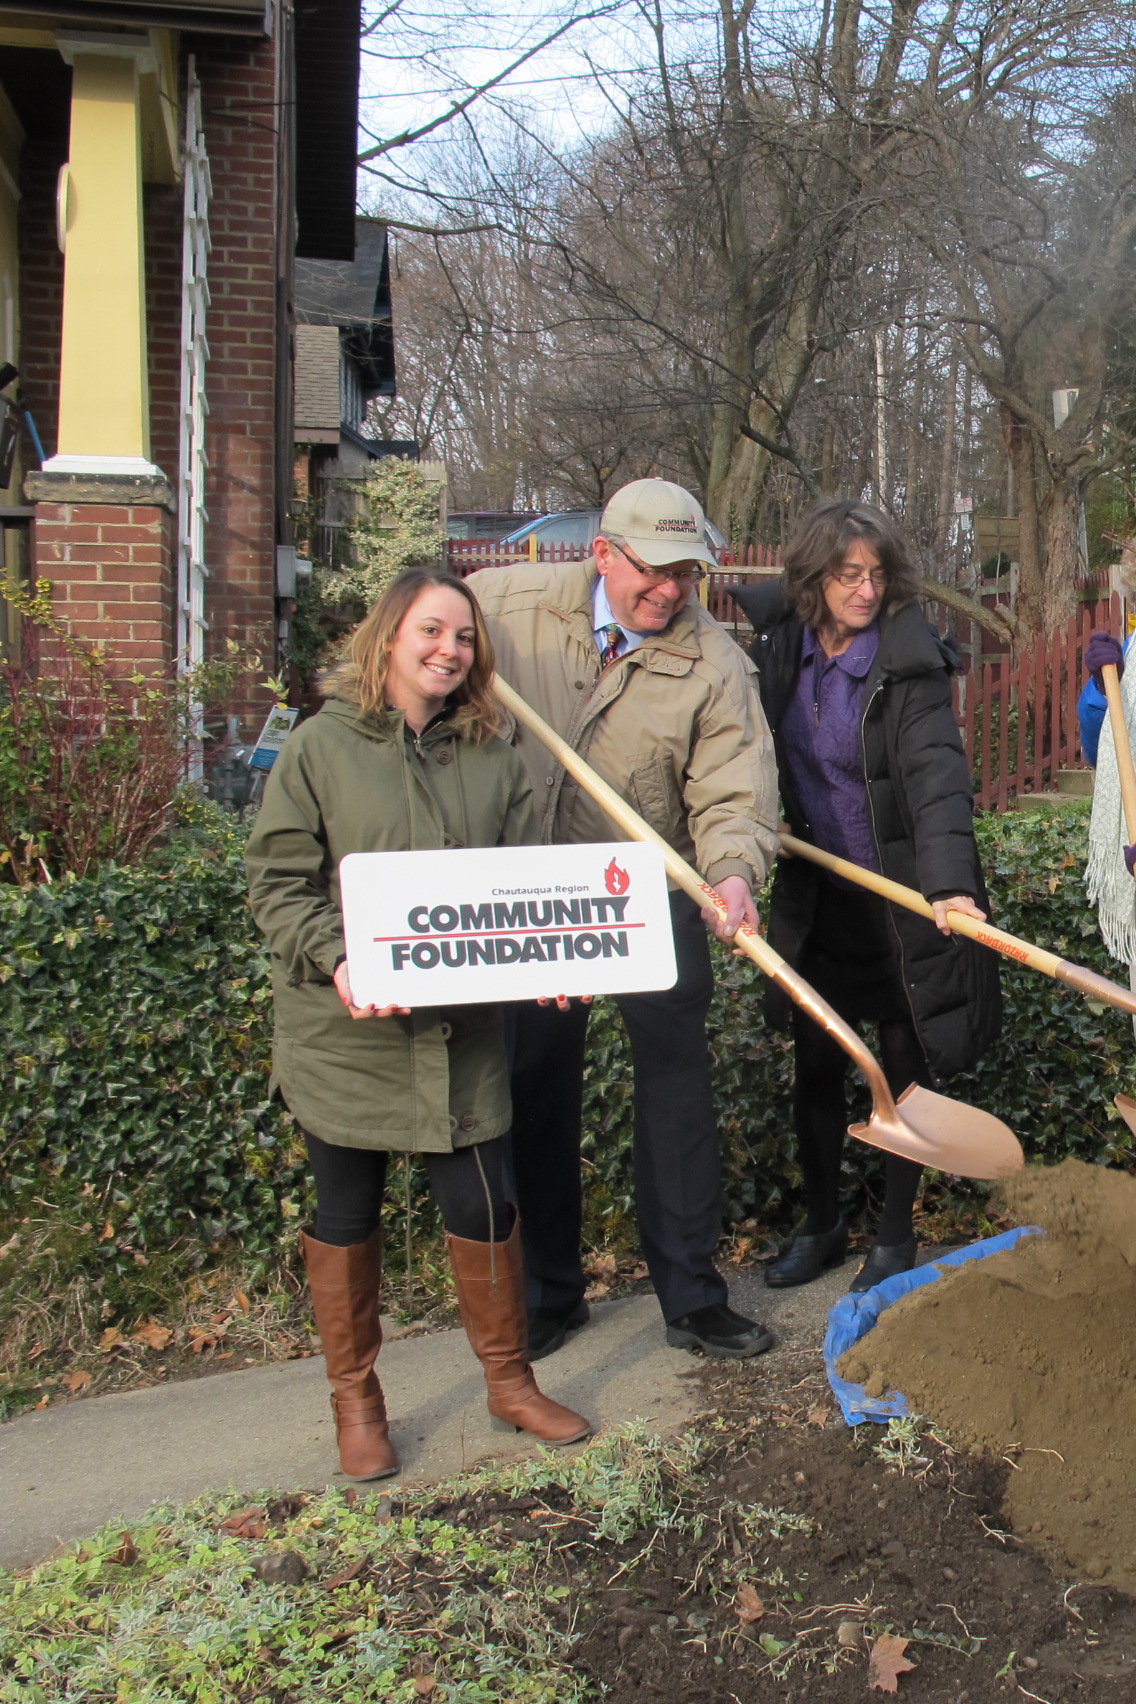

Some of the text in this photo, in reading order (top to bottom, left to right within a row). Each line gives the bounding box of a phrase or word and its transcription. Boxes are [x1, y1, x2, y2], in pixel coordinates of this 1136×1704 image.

[655, 526, 698, 534] FOUNDATION
[658, 519, 696, 527] COMMUNITY
[491, 884, 590, 896] Chautauqua Region
[407, 896, 631, 933] COMMUNITY
[391, 931, 629, 970] FOUNDATION
[976, 931, 1030, 963] RAZORBACK
